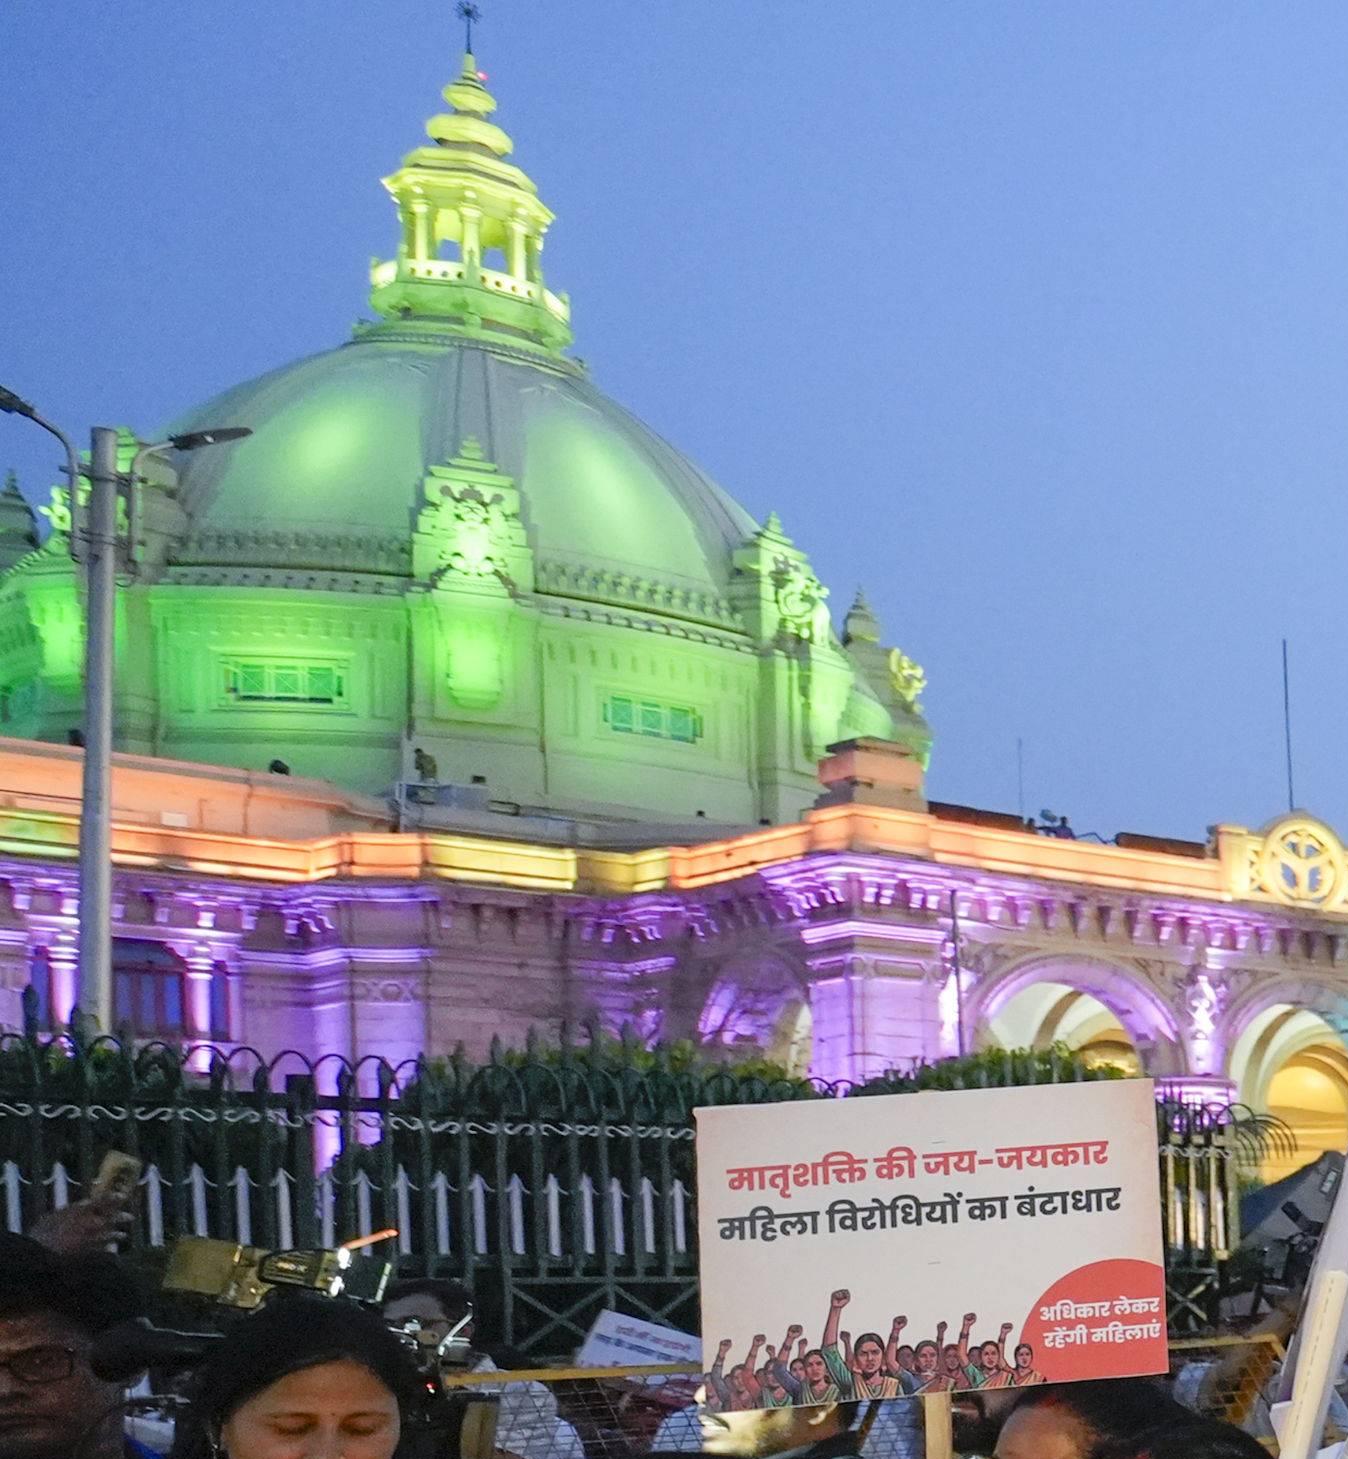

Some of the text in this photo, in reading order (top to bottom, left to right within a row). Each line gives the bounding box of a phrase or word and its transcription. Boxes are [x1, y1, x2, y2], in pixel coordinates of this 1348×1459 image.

[726, 1141, 1109, 1198] मातृशक्ति की जय-जयकार
[717, 1186, 1121, 1241] महिला विरोधियों का बंटाधार
[1040, 1296, 1160, 1321] अधिकार लेकर
[1043, 1319, 1161, 1348] रहेंगी महिलाएं
